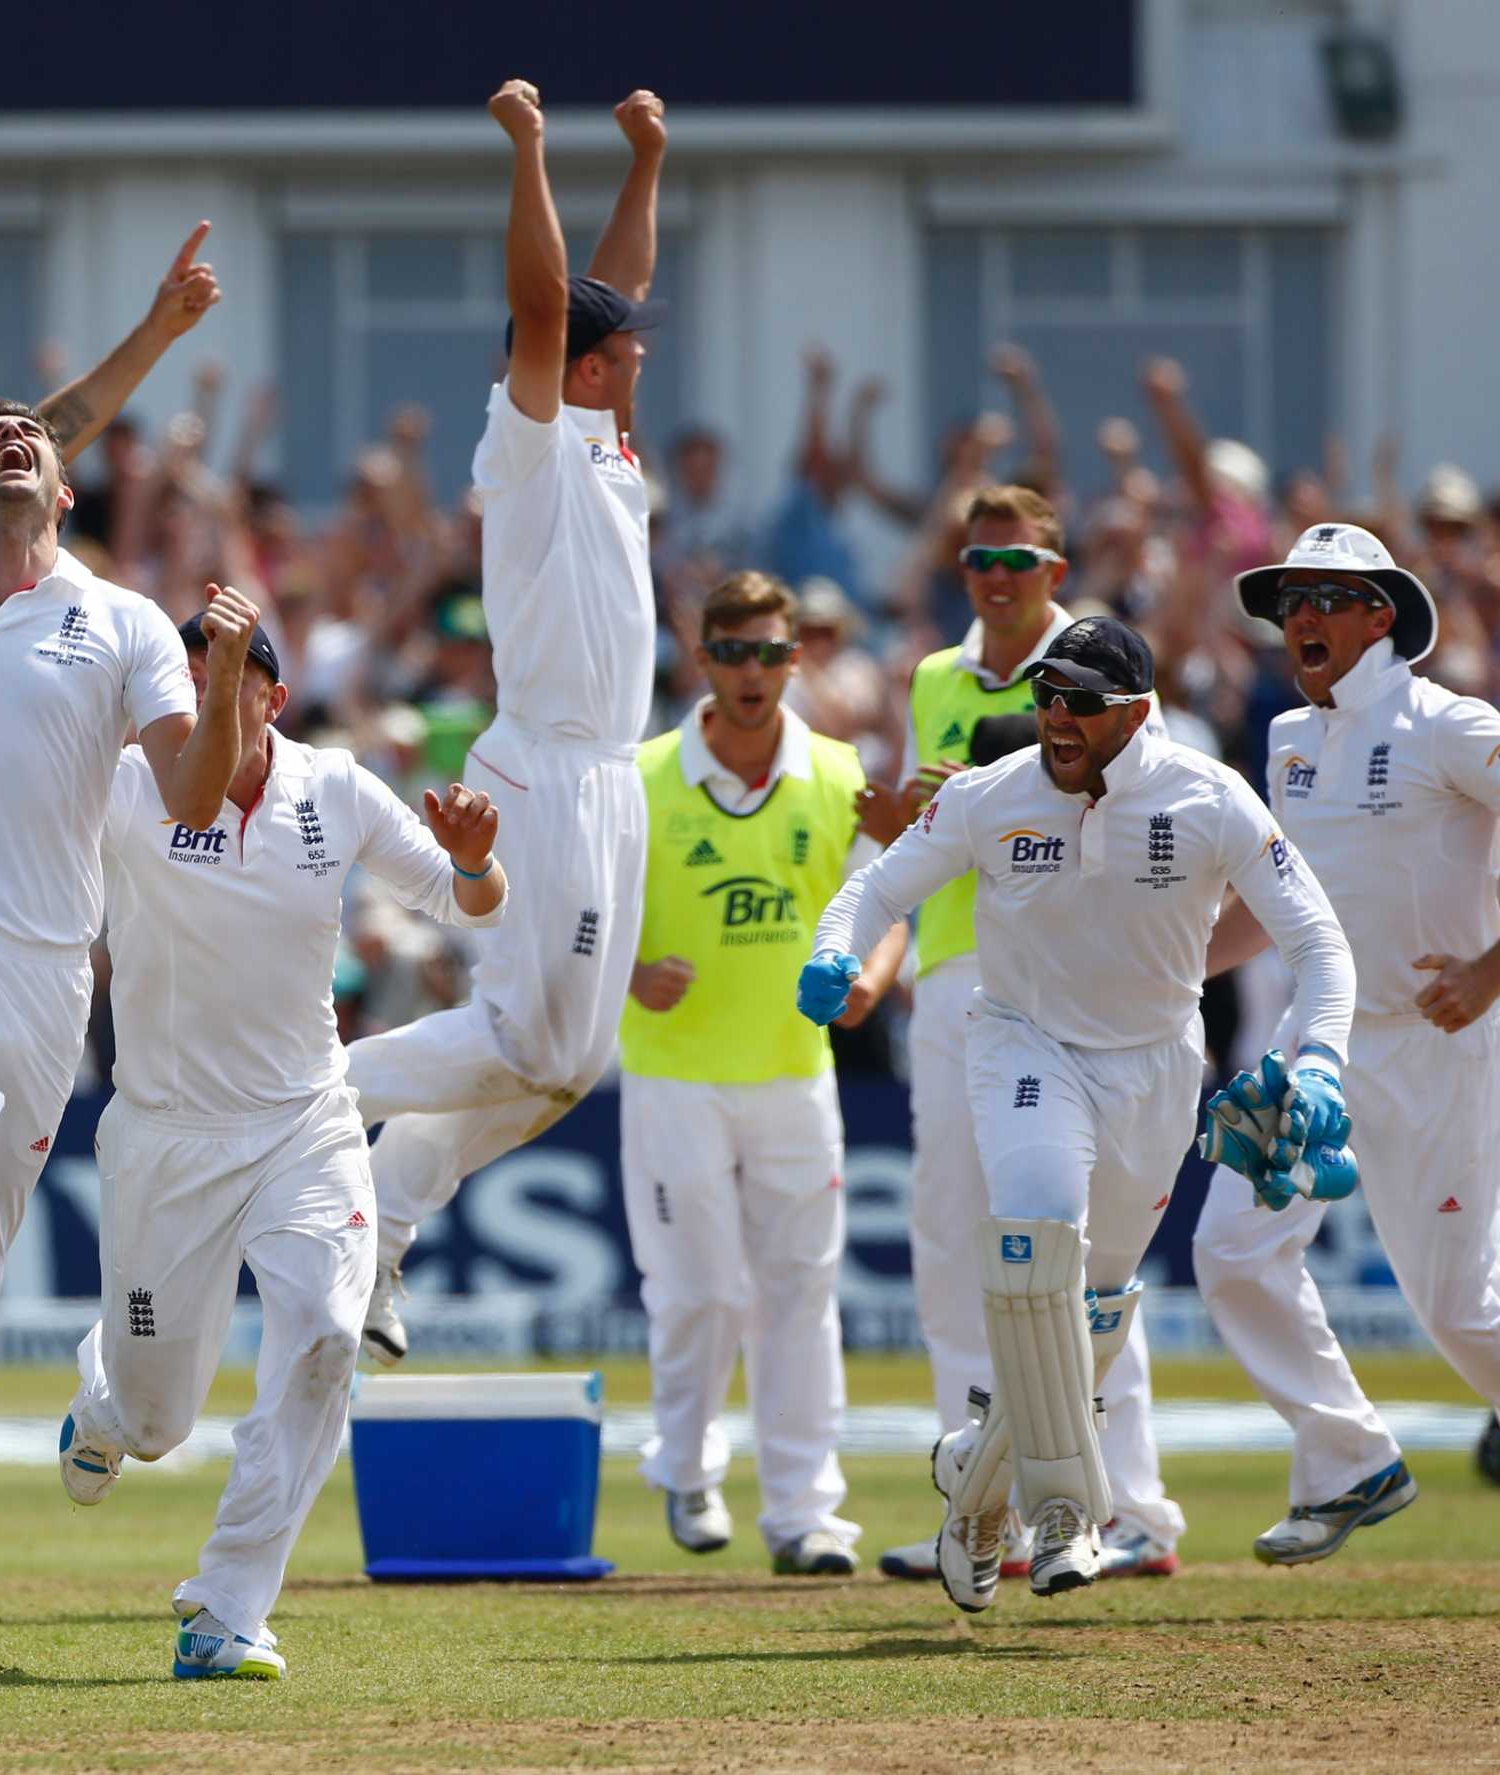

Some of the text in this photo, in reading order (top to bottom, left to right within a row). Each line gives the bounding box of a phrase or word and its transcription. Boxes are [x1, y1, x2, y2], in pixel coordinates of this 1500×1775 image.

[171, 823, 227, 853] Brit
[307, 849, 326, 860] 652
[1012, 836, 1066, 862] Brit
[168, 850, 221, 865] Insurance
[1011, 863, 1061, 873] Insurance
[1150, 866, 1171, 875] 635
[723, 888, 798, 926] Brit
